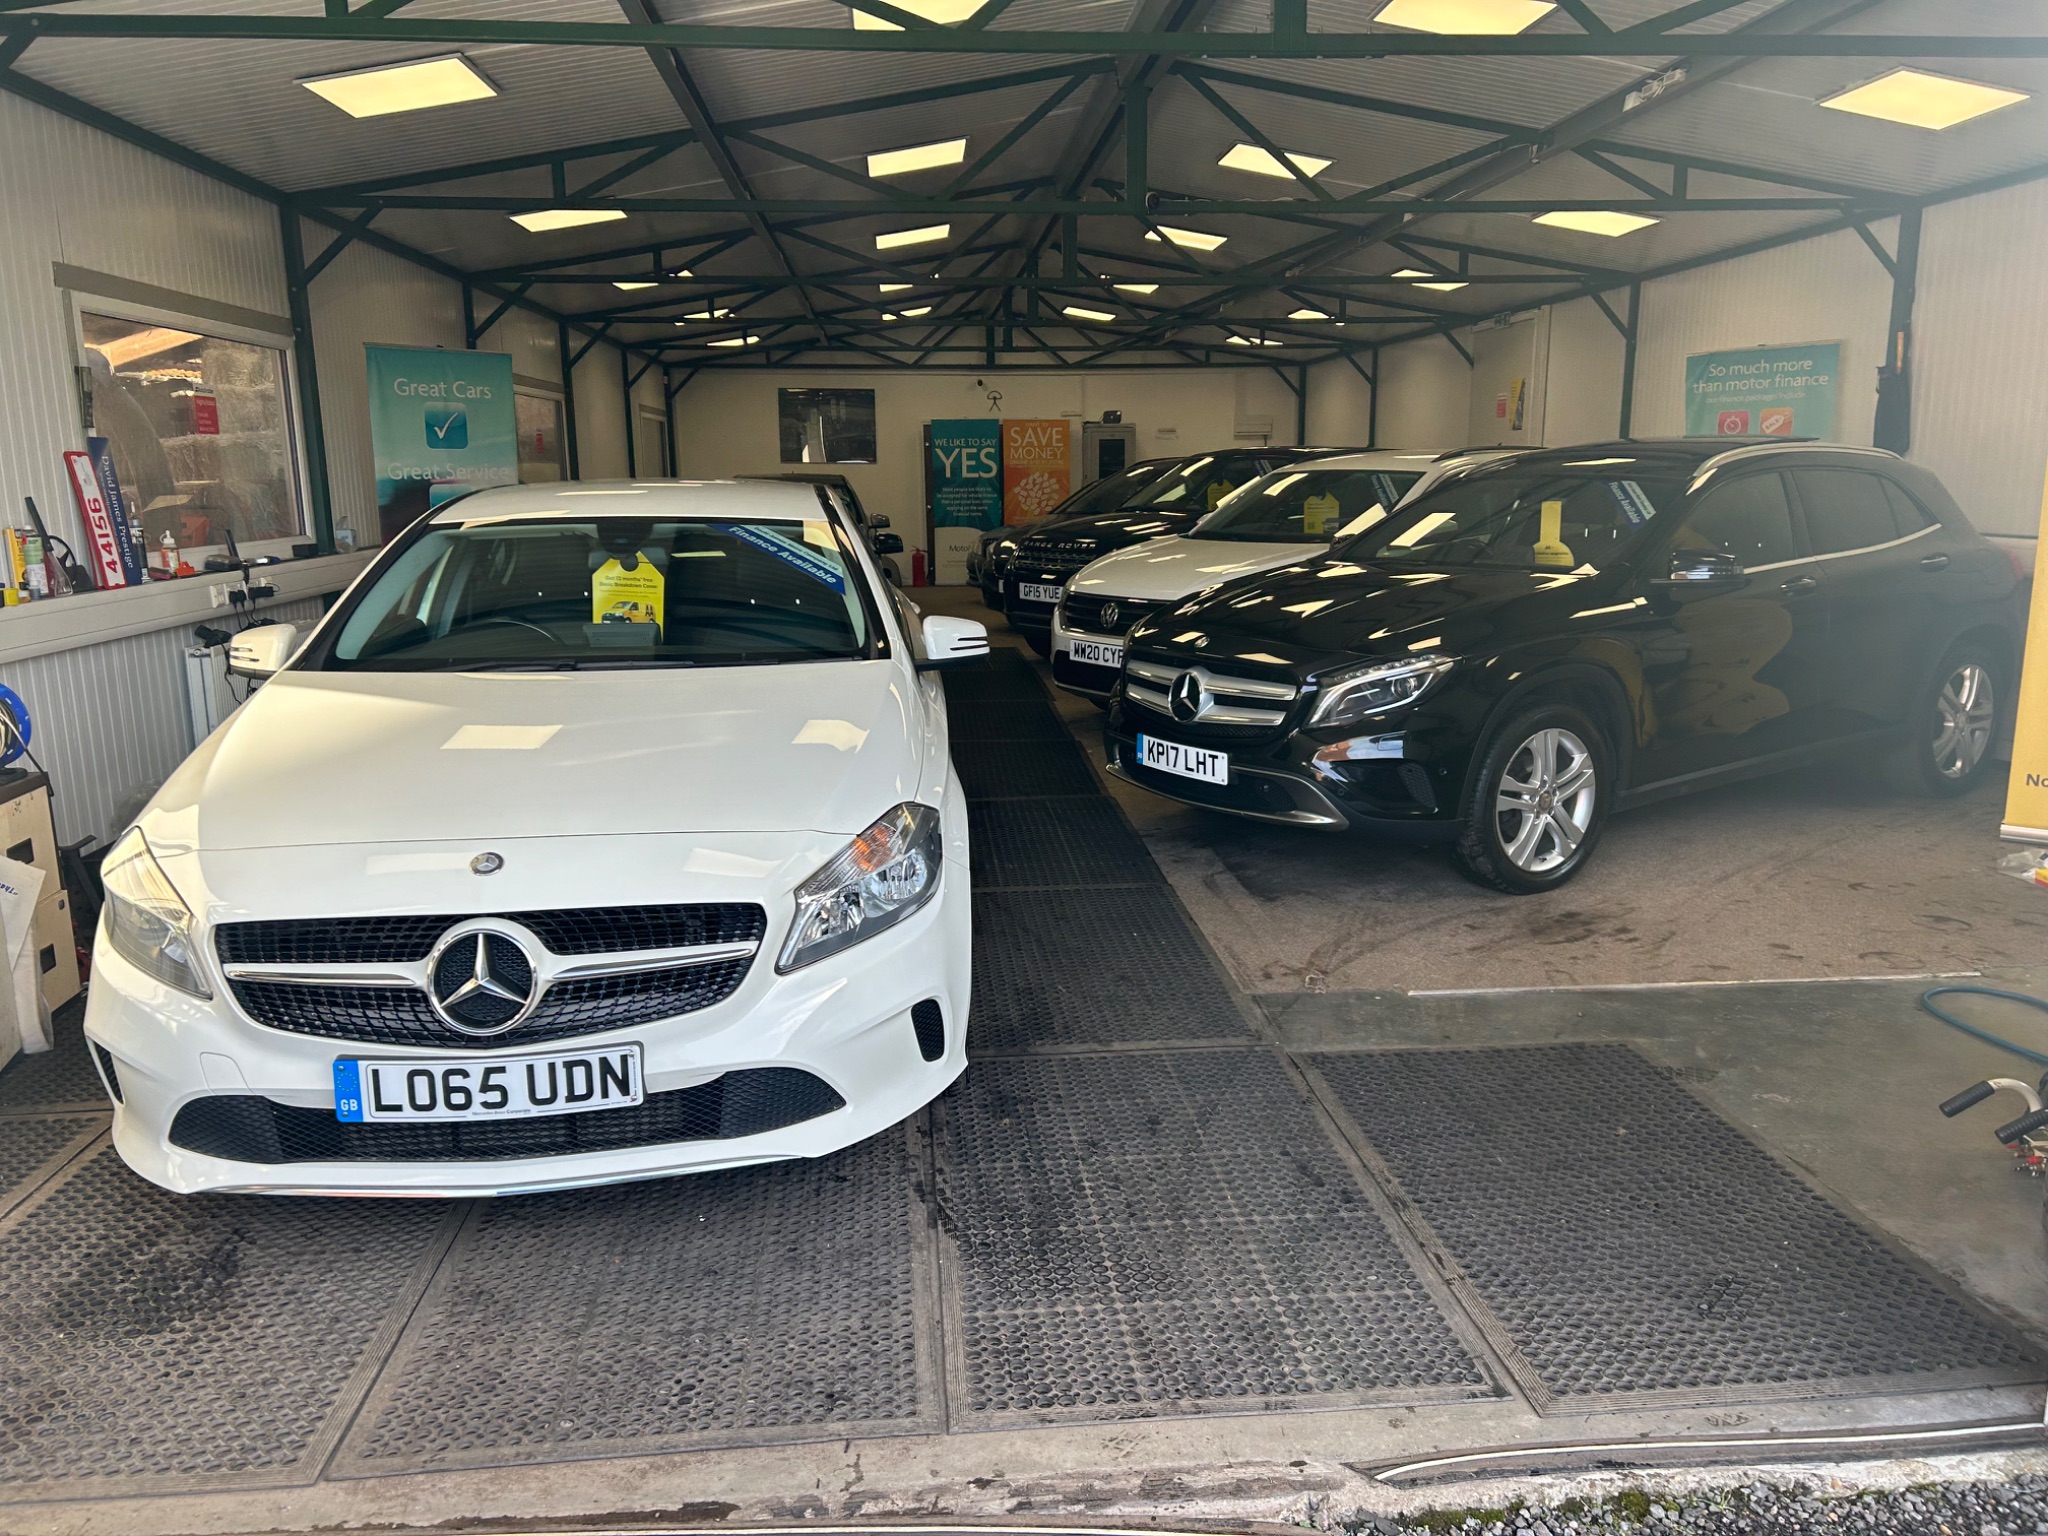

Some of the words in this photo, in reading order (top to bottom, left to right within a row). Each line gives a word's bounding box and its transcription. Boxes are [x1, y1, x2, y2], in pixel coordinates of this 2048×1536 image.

[1708, 364, 1726, 377] So
[1729, 359, 1770, 376] much
[1773, 360, 1813, 372] more
[394, 378, 447, 397] Great
[452, 381, 492, 398] Cars
[1693, 380, 1722, 394] than
[1726, 378, 1772, 391] motor
[1775, 374, 1829, 388] finance
[1010, 427, 1063, 447] SAVE
[935, 447, 997, 478] YES
[1010, 447, 1063, 459] MONEY
[101, 456, 116, 488] David
[388, 462, 440, 480] Great
[446, 463, 509, 480] Service
[108, 488, 122, 522] James
[87, 497, 118, 574] 44156
[118, 526, 133, 568] Prestige
[728, 526, 778, 553] Finance
[777, 551, 837, 584] Available
[1024, 585, 1041, 598] GF15
[1043, 587, 1060, 599] YUE
[1147, 739, 1179, 768] KP17
[1184, 749, 1218, 777] LHT
[371, 1066, 509, 1112] LO65
[526, 1054, 632, 1106] UDN
[340, 1099, 359, 1111] GB
